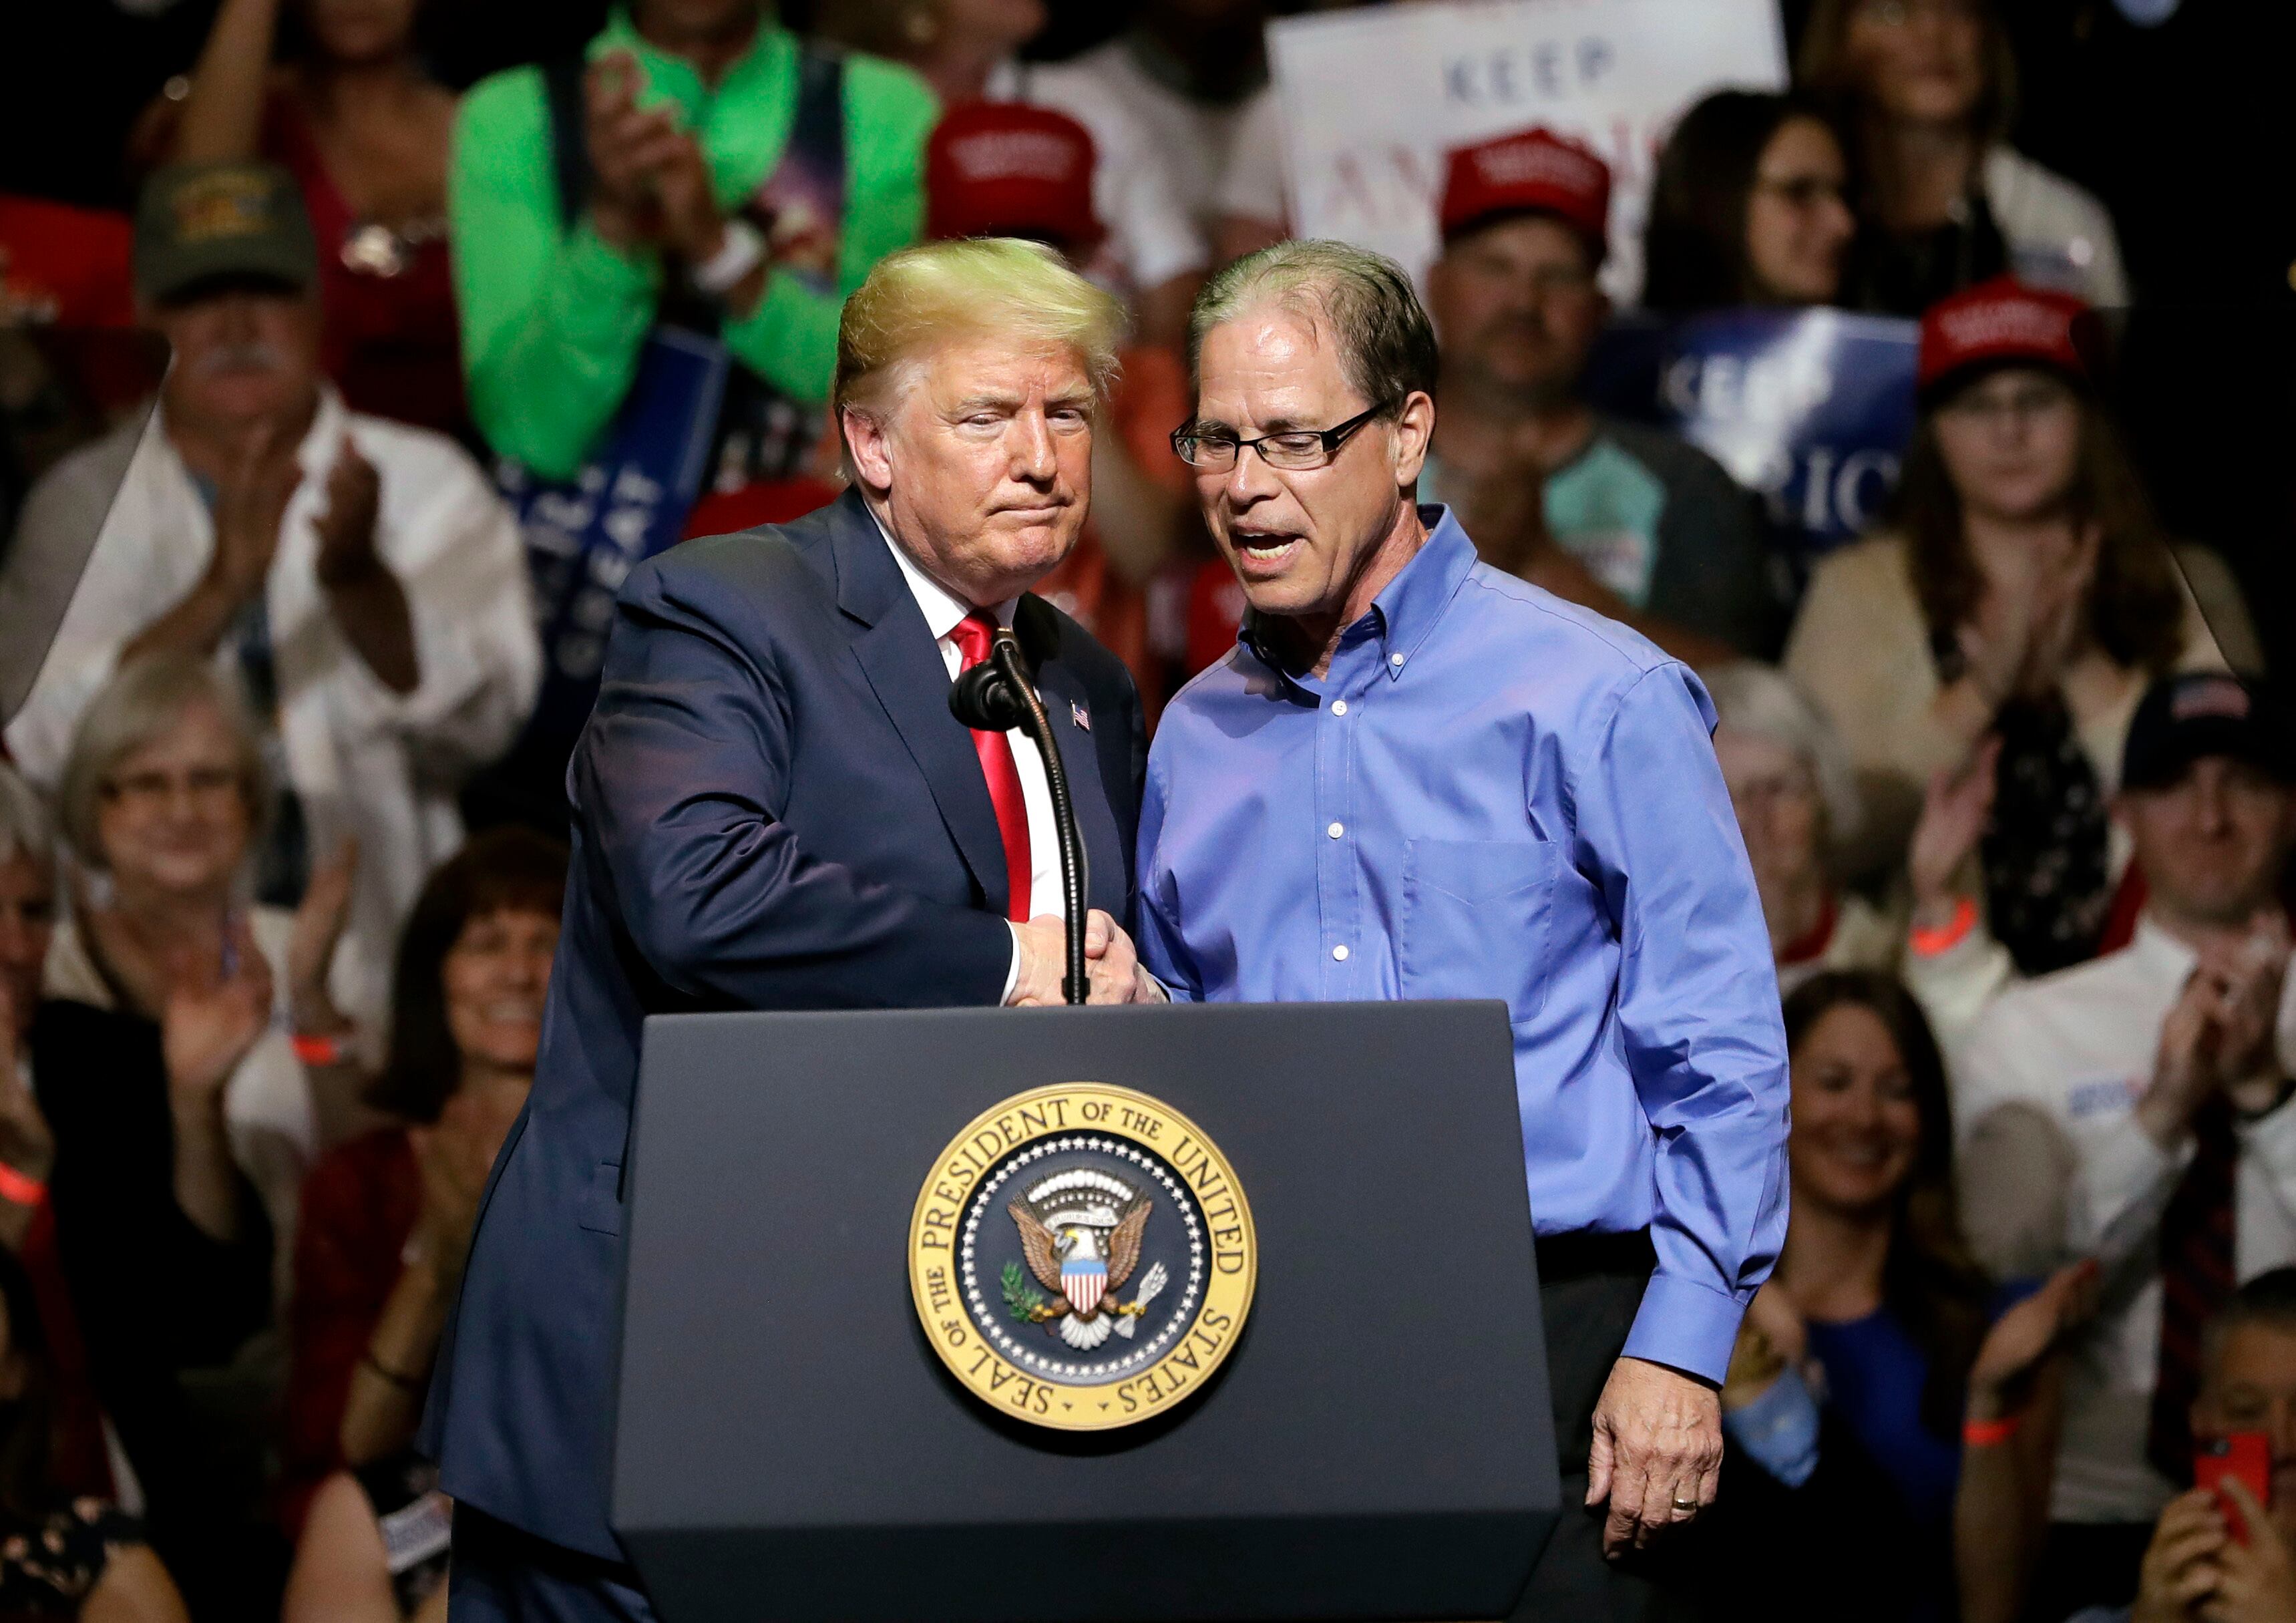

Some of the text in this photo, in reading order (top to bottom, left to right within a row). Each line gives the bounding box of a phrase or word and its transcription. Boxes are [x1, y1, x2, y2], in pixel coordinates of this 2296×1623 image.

[1444, 35, 1615, 105] KEEP
[921, 1099, 1243, 1415] SEAL OF THE PRESIDENT OF THE UNITED STATES
